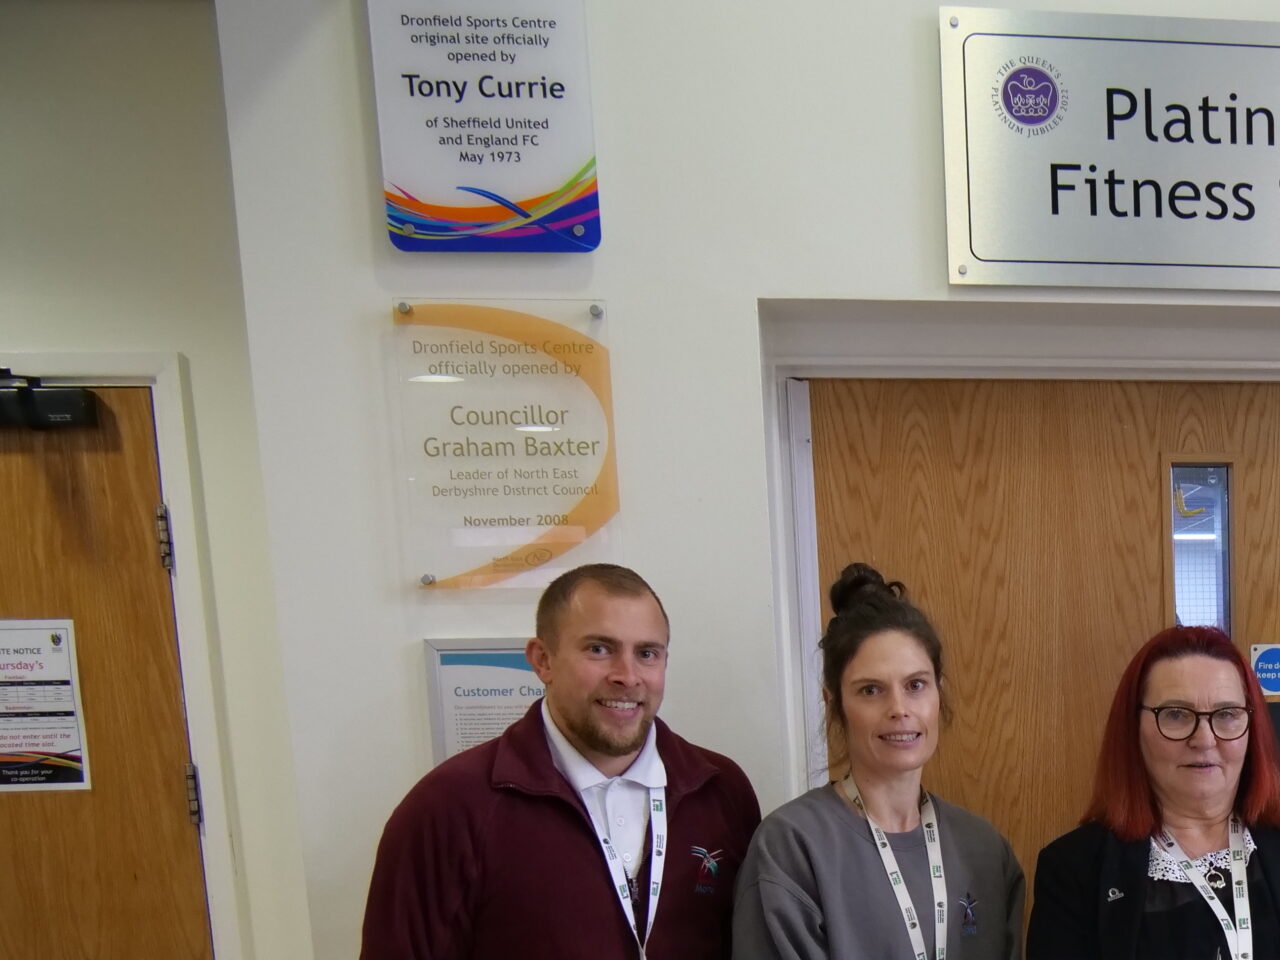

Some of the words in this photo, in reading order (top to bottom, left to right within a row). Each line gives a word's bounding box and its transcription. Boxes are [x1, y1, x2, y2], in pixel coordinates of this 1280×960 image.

[400, 14, 463, 28] Dronfield
[466, 16, 508, 30] Sports
[512, 17, 557, 29] Centre
[410, 32, 461, 47] original
[464, 34, 490, 45] site
[493, 33, 550, 48] officially
[447, 50, 496, 64] opened
[500, 50, 516, 64] by
[997, 59, 1016, 77] THE
[1019, 56, 1062, 79] QUEEN'S
[401, 74, 468, 103] Tony
[478, 75, 566, 99] Currie
[991, 87, 1023, 135] PLATINUM
[1027, 113, 1064, 138] JUBILEE
[1060, 89, 1069, 112] 2022
[425, 117, 439, 129] of
[443, 117, 501, 129] Sheffield
[506, 118, 549, 130] United
[438, 134, 463, 146] and
[467, 135, 518, 148] England
[523, 135, 540, 146] FC
[459, 151, 485, 165] May
[490, 151, 521, 163] 1973
[1050, 162, 1256, 221] Fitness
[412, 340, 484, 355] Dronfield
[490, 341, 537, 357] Sports
[542, 341, 594, 355] Centre
[428, 361, 497, 377] officially
[502, 362, 558, 377] opened
[564, 362, 582, 377] by
[450, 405, 569, 427] Councillor
[423, 436, 516, 458] Graham
[524, 436, 600, 457] Baxter
[449, 469, 492, 480] Leader
[497, 468, 509, 480] of
[514, 468, 549, 480] North
[552, 468, 579, 480] East
[432, 485, 499, 499] Derbyshire
[503, 484, 548, 497] District
[552, 484, 599, 497] Council
[463, 516, 531, 527] November
[537, 514, 569, 526] 2008
[1256, 671, 1276, 679] keep
[454, 686, 514, 697] Customer
